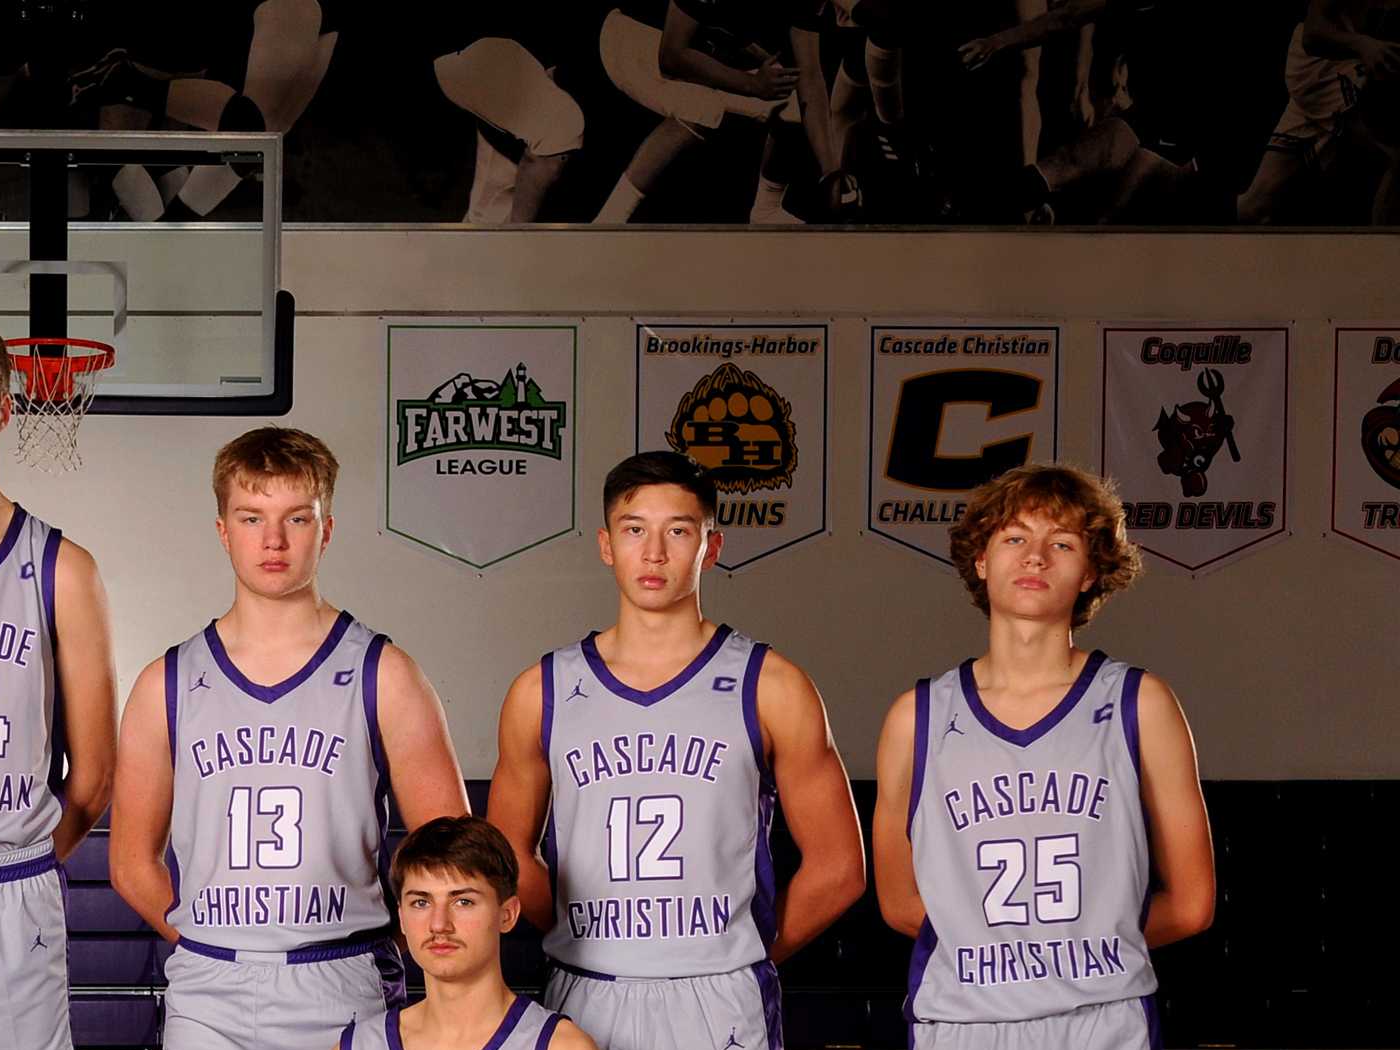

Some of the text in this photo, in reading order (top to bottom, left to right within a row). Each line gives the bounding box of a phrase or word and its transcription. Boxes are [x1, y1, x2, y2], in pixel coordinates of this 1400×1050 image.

[646, 336, 818, 358] Brookings-Harbor
[879, 336, 1050, 355] Cascade Christian
[1142, 336, 1252, 370] Coquille
[436, 459, 528, 475] LEAGUE
[717, 502, 785, 527] UINS
[1176, 502, 1276, 529] DEVILS
[190, 726, 346, 779] CASCADE
[564, 732, 729, 789] CASCADE
[944, 770, 1111, 832] CASCADE
[227, 786, 303, 870] 13
[606, 794, 684, 882] 12
[977, 832, 1082, 928] 25
[192, 884, 347, 928] CHRISTIAN
[567, 894, 732, 941] CHRISTIAN
[957, 936, 1127, 986] CHRISTIAN
